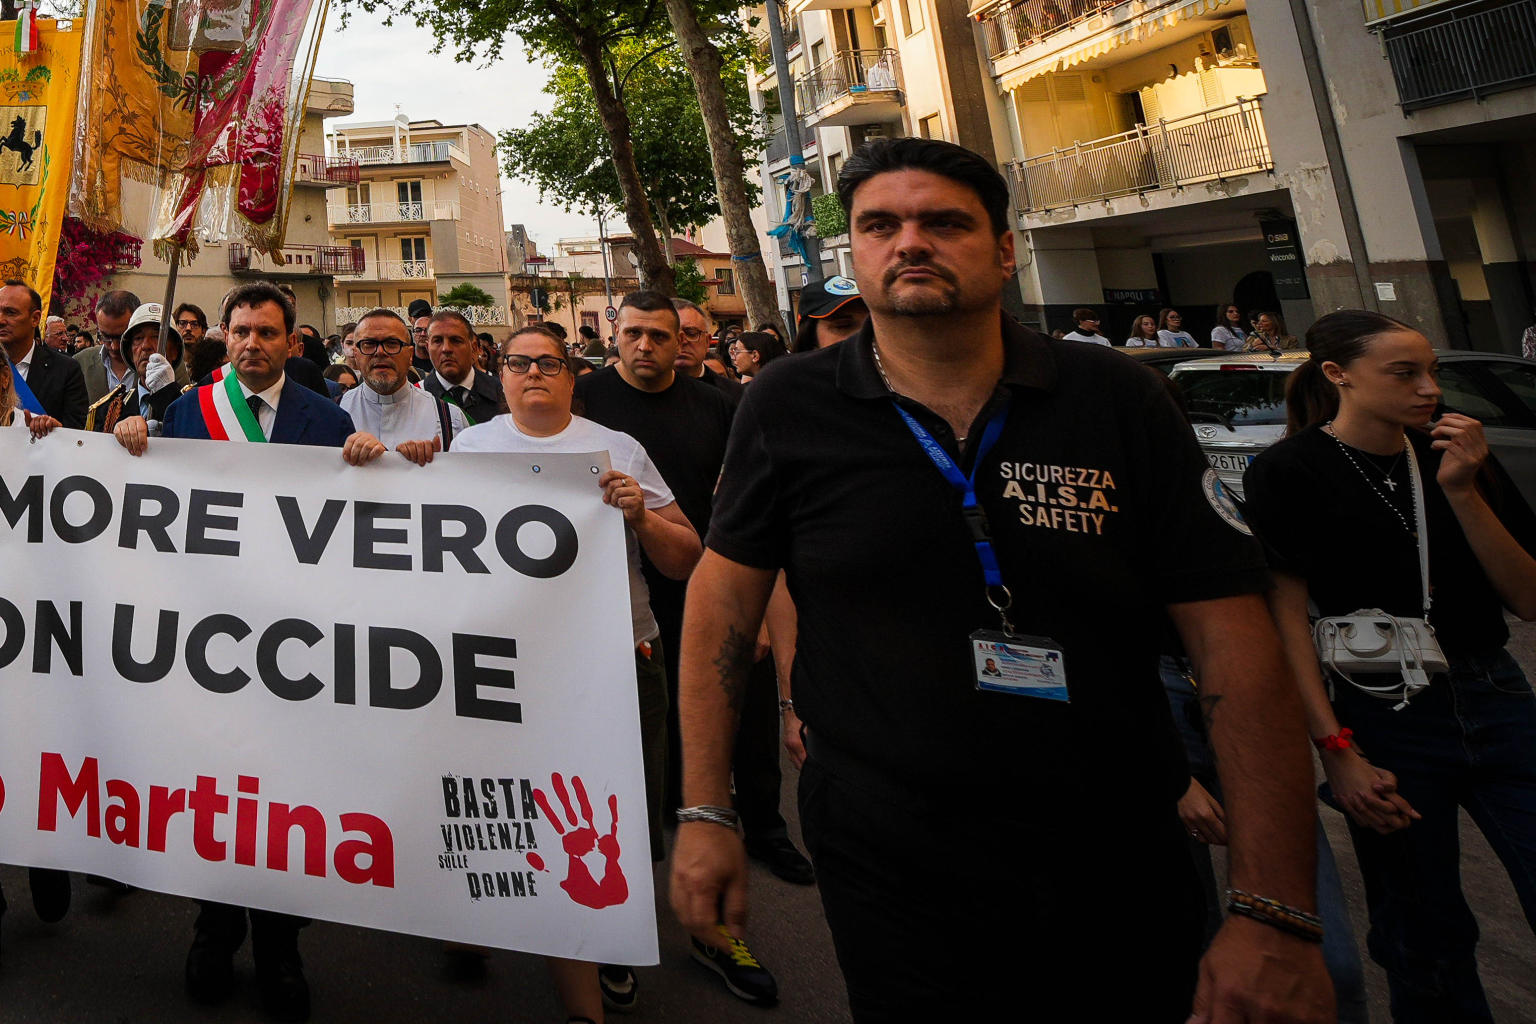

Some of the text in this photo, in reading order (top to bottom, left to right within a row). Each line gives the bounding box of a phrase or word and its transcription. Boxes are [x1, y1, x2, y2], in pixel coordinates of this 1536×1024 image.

[607, 310, 615, 318] 30
[1000, 461, 1117, 490] SICUREZZA
[1002, 480, 1119, 513] A.I.S.A.
[1019, 503, 1105, 535] SAFETY
[275, 494, 580, 580] VERO
[111, 602, 524, 725] UCCIDE
[440, 776, 539, 820] BASTA
[36, 751, 396, 889] Martina
[440, 822, 538, 852] VIOLENZA
[438, 854, 469, 870] SULLE
[466, 871, 538, 900] DONNE
